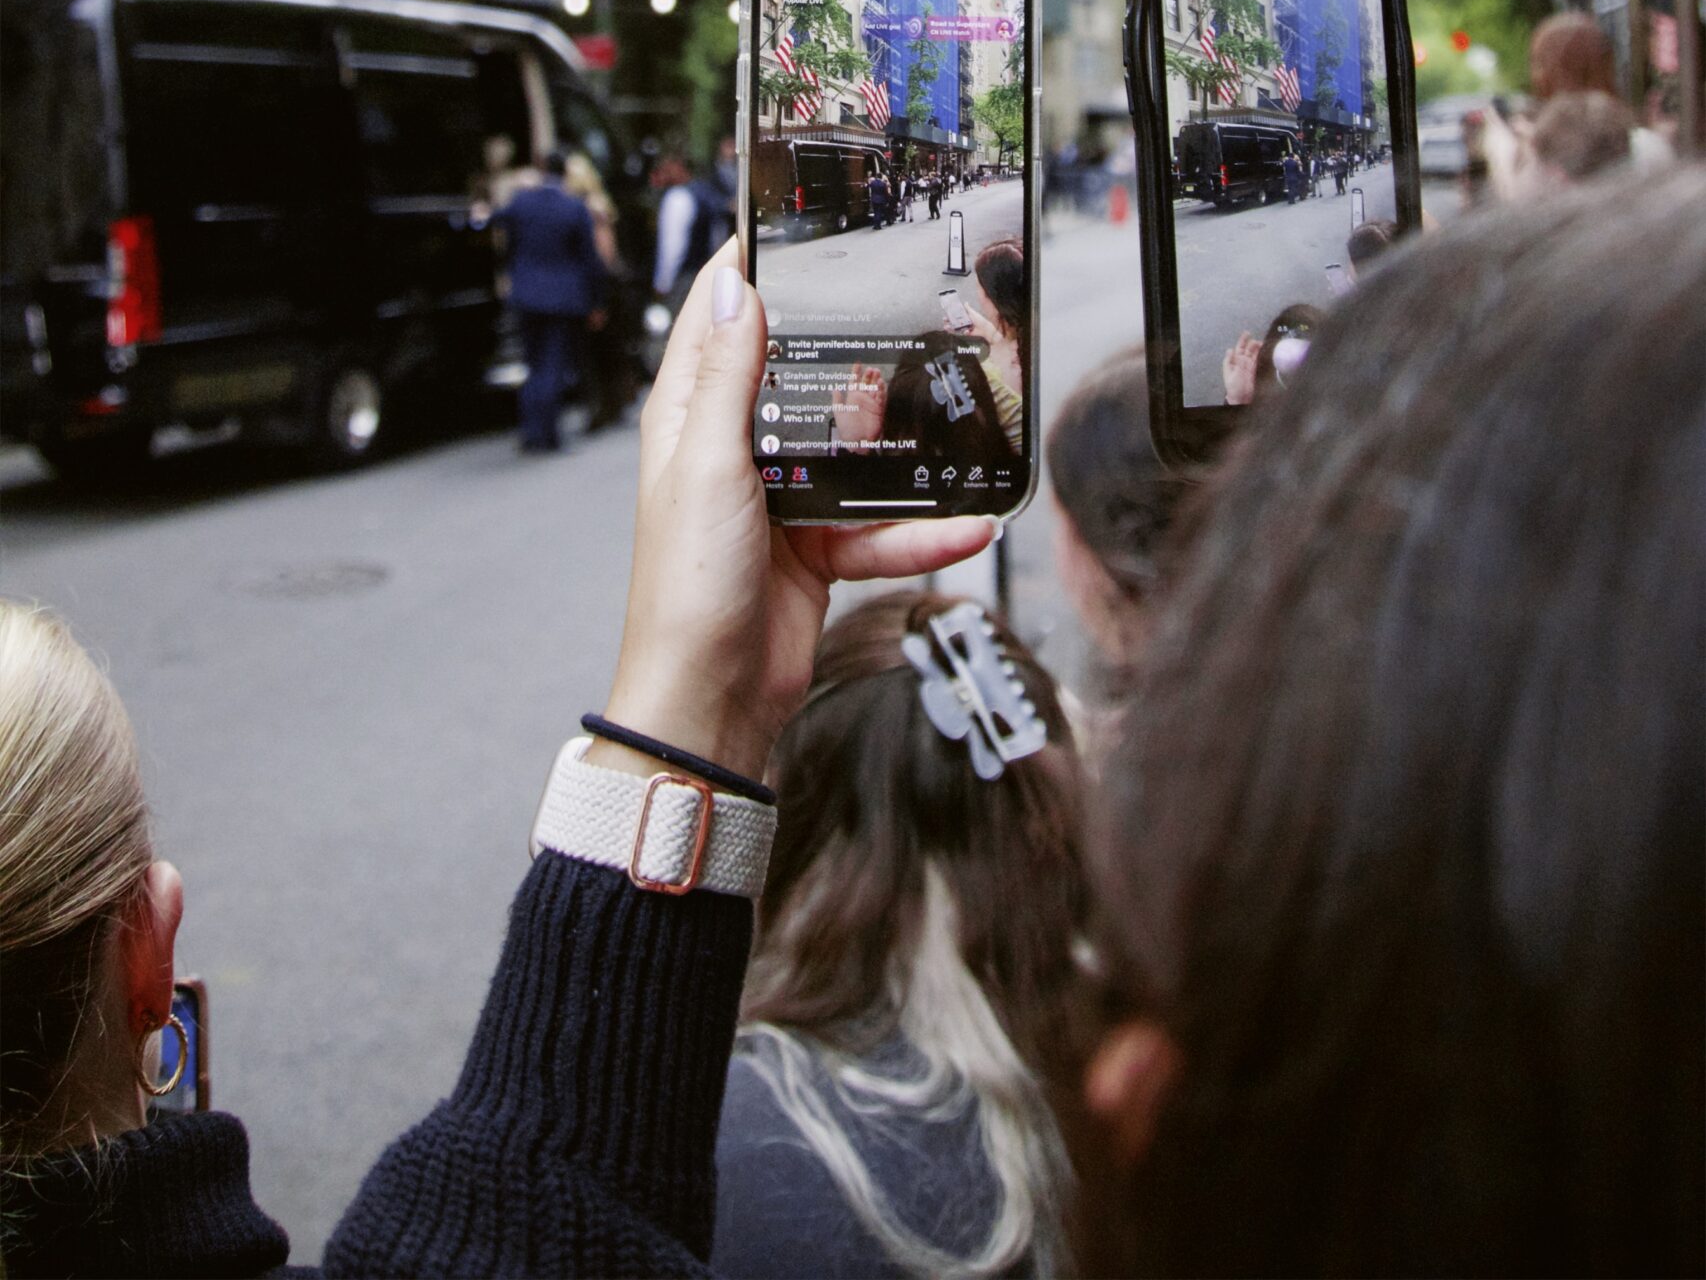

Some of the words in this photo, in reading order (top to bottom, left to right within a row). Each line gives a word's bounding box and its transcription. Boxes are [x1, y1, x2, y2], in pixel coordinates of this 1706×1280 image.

[788, 340, 812, 349] Invite
[812, 340, 865, 350] jenniferbabs
[866, 341, 876, 349] to
[877, 340, 893, 350] join
[895, 341, 913, 349] LIVE
[957, 346, 981, 354] Invite
[794, 350, 819, 360] guest
[783, 372, 816, 380] Graham
[818, 371, 858, 380] Davidson
[800, 383, 819, 392] give
[835, 383, 847, 391] lot
[848, 383, 858, 391] of
[859, 383, 879, 391] likes
[783, 414, 803, 423] Who
[804, 414, 812, 422] is
[813, 414, 825, 422] it?
[860, 440, 881, 449] liked
[882, 440, 897, 449] the
[898, 440, 917, 449] LIVE
